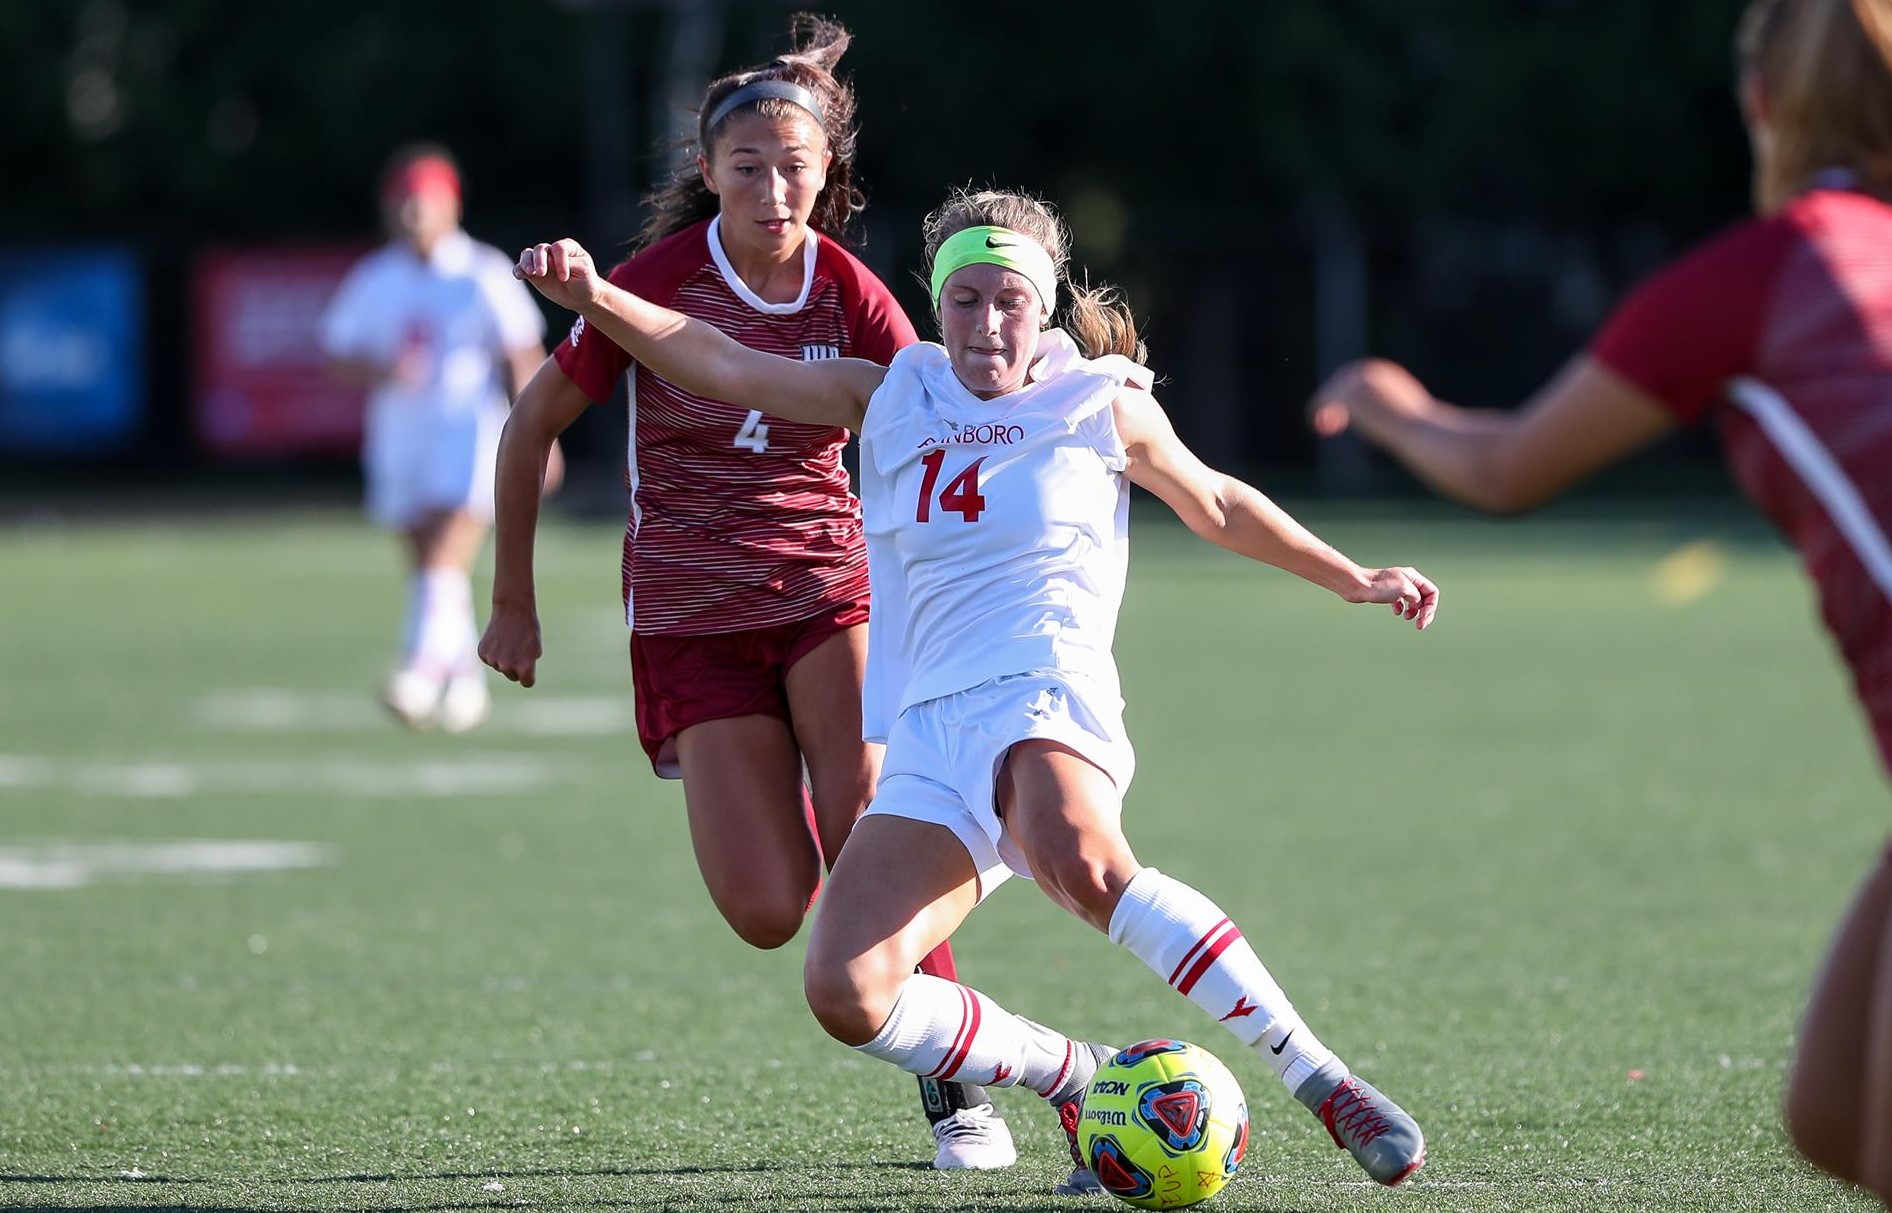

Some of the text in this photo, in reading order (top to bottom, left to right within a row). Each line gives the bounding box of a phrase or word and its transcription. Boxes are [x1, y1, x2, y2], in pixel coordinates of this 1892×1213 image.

[735, 409, 769, 454] 4
[916, 448, 989, 523] 14
[1093, 1081, 1130, 1096] NCAA
[1085, 1110, 1127, 1126] Wilson
